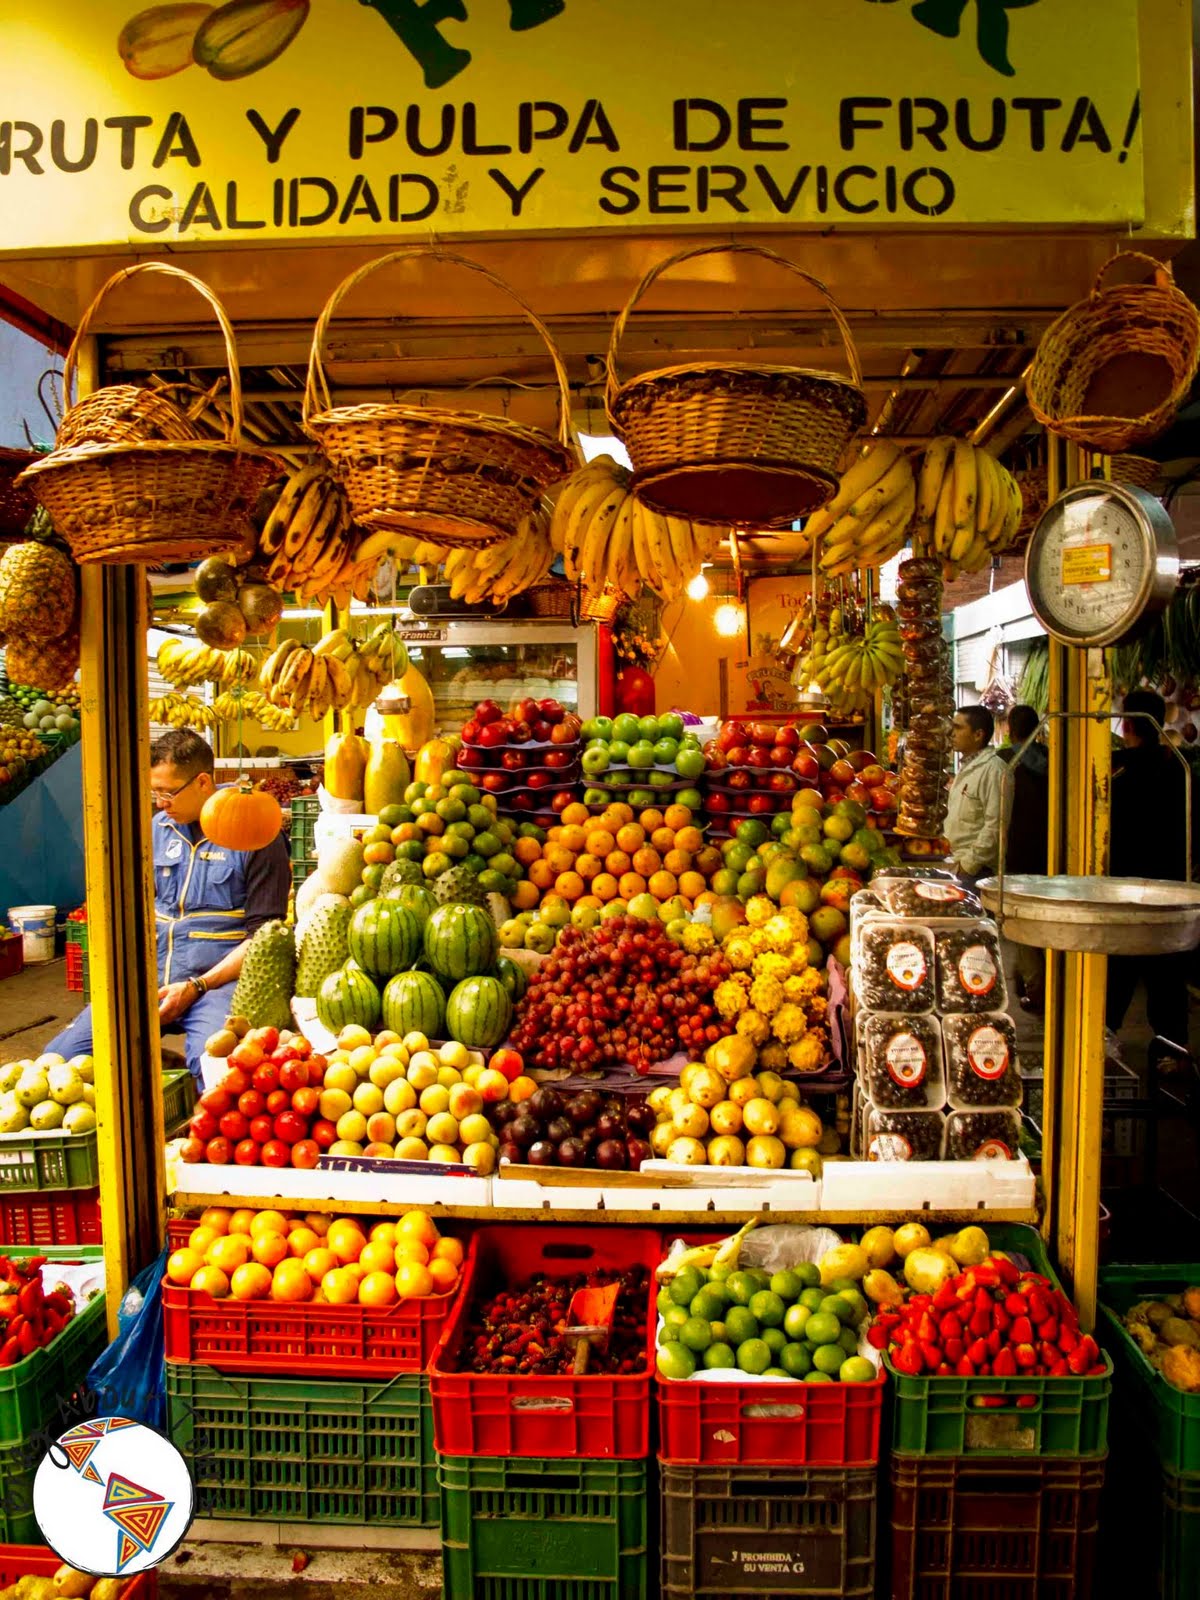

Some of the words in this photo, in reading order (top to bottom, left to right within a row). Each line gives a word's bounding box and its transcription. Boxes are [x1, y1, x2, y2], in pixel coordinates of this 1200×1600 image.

[0, 111, 201, 176] RUTA
[246, 107, 301, 164] Y
[348, 99, 620, 160] PULPA
[673, 97, 789, 153] DE
[839, 88, 1141, 164] FRUTA!
[128, 173, 440, 234] CALIDAD
[488, 168, 545, 217] Y
[599, 164, 955, 216] SERVICIO
[740, 1552, 793, 1563] PROHIBIDA
[743, 1563, 757, 1573] SU
[758, 1563, 791, 1573] VENTA
